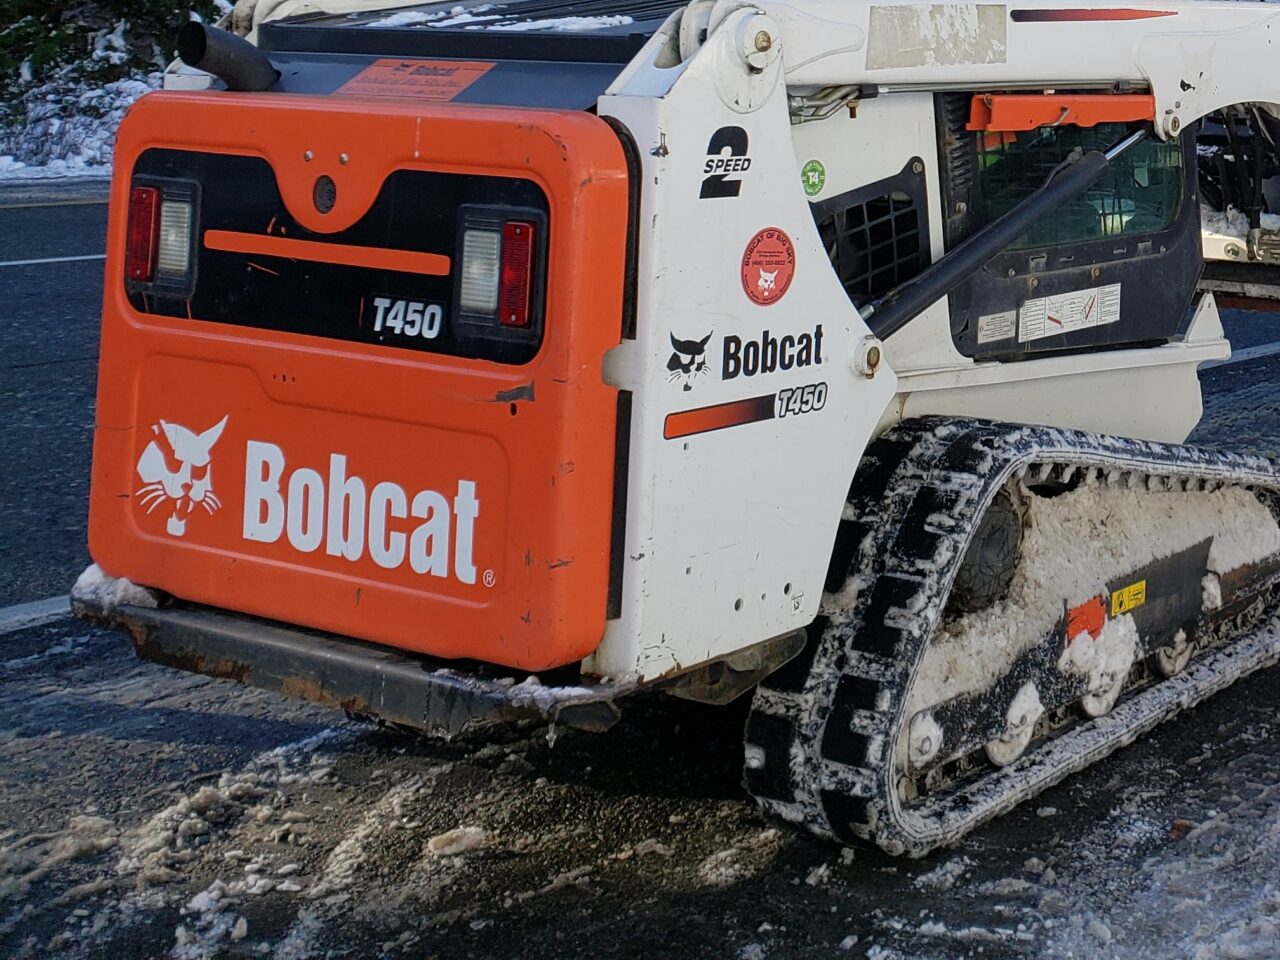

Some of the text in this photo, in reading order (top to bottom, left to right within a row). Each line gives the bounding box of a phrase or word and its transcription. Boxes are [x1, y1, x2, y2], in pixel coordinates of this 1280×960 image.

[699, 126, 748, 199] 2
[704, 158, 751, 174] SPEED
[808, 172, 819, 185] T4
[744, 234, 764, 266] BOBCAT
[776, 235, 786, 246] BIG
[373, 296, 442, 340] T450
[722, 324, 823, 380] Bobcat
[779, 382, 828, 418] T450
[242, 440, 480, 585] Bobcat
